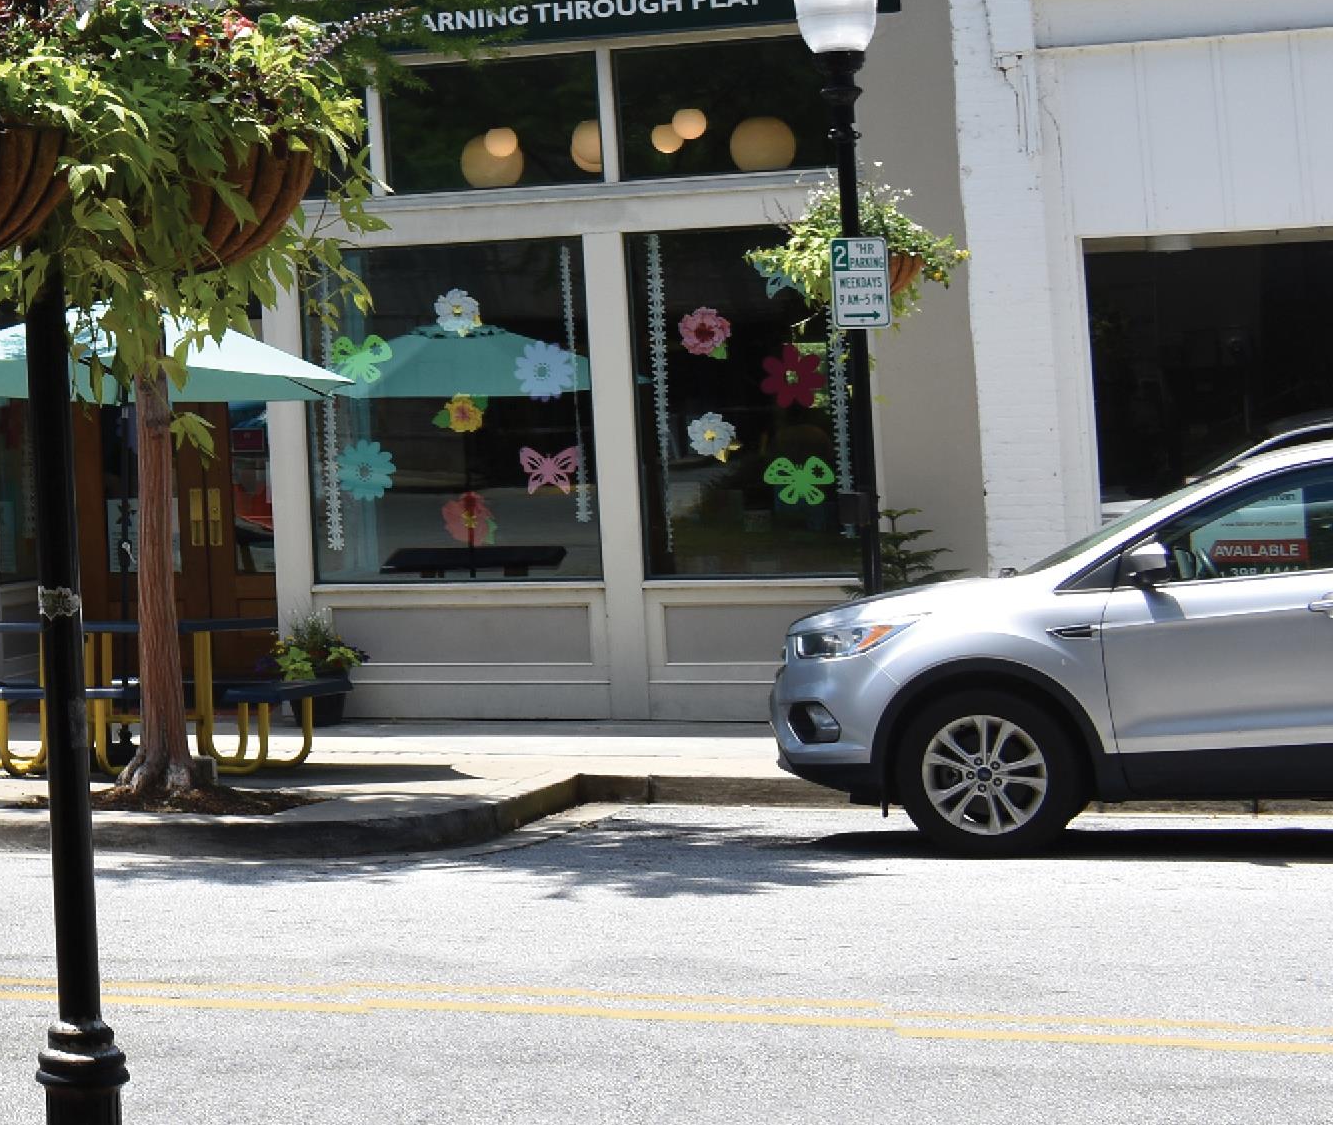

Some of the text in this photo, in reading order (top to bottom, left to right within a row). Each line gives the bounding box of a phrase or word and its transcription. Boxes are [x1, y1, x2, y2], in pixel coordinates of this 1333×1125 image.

[386, 4, 529, 33] ARNING
[833, 245, 847, 267] 2
[850, 257, 884, 268] PARKING
[839, 276, 882, 288] WEEKDAYS
[839, 294, 844, 305] 9
[873, 293, 884, 304] PM
[1215, 544, 1300, 556] AVAILABLE
